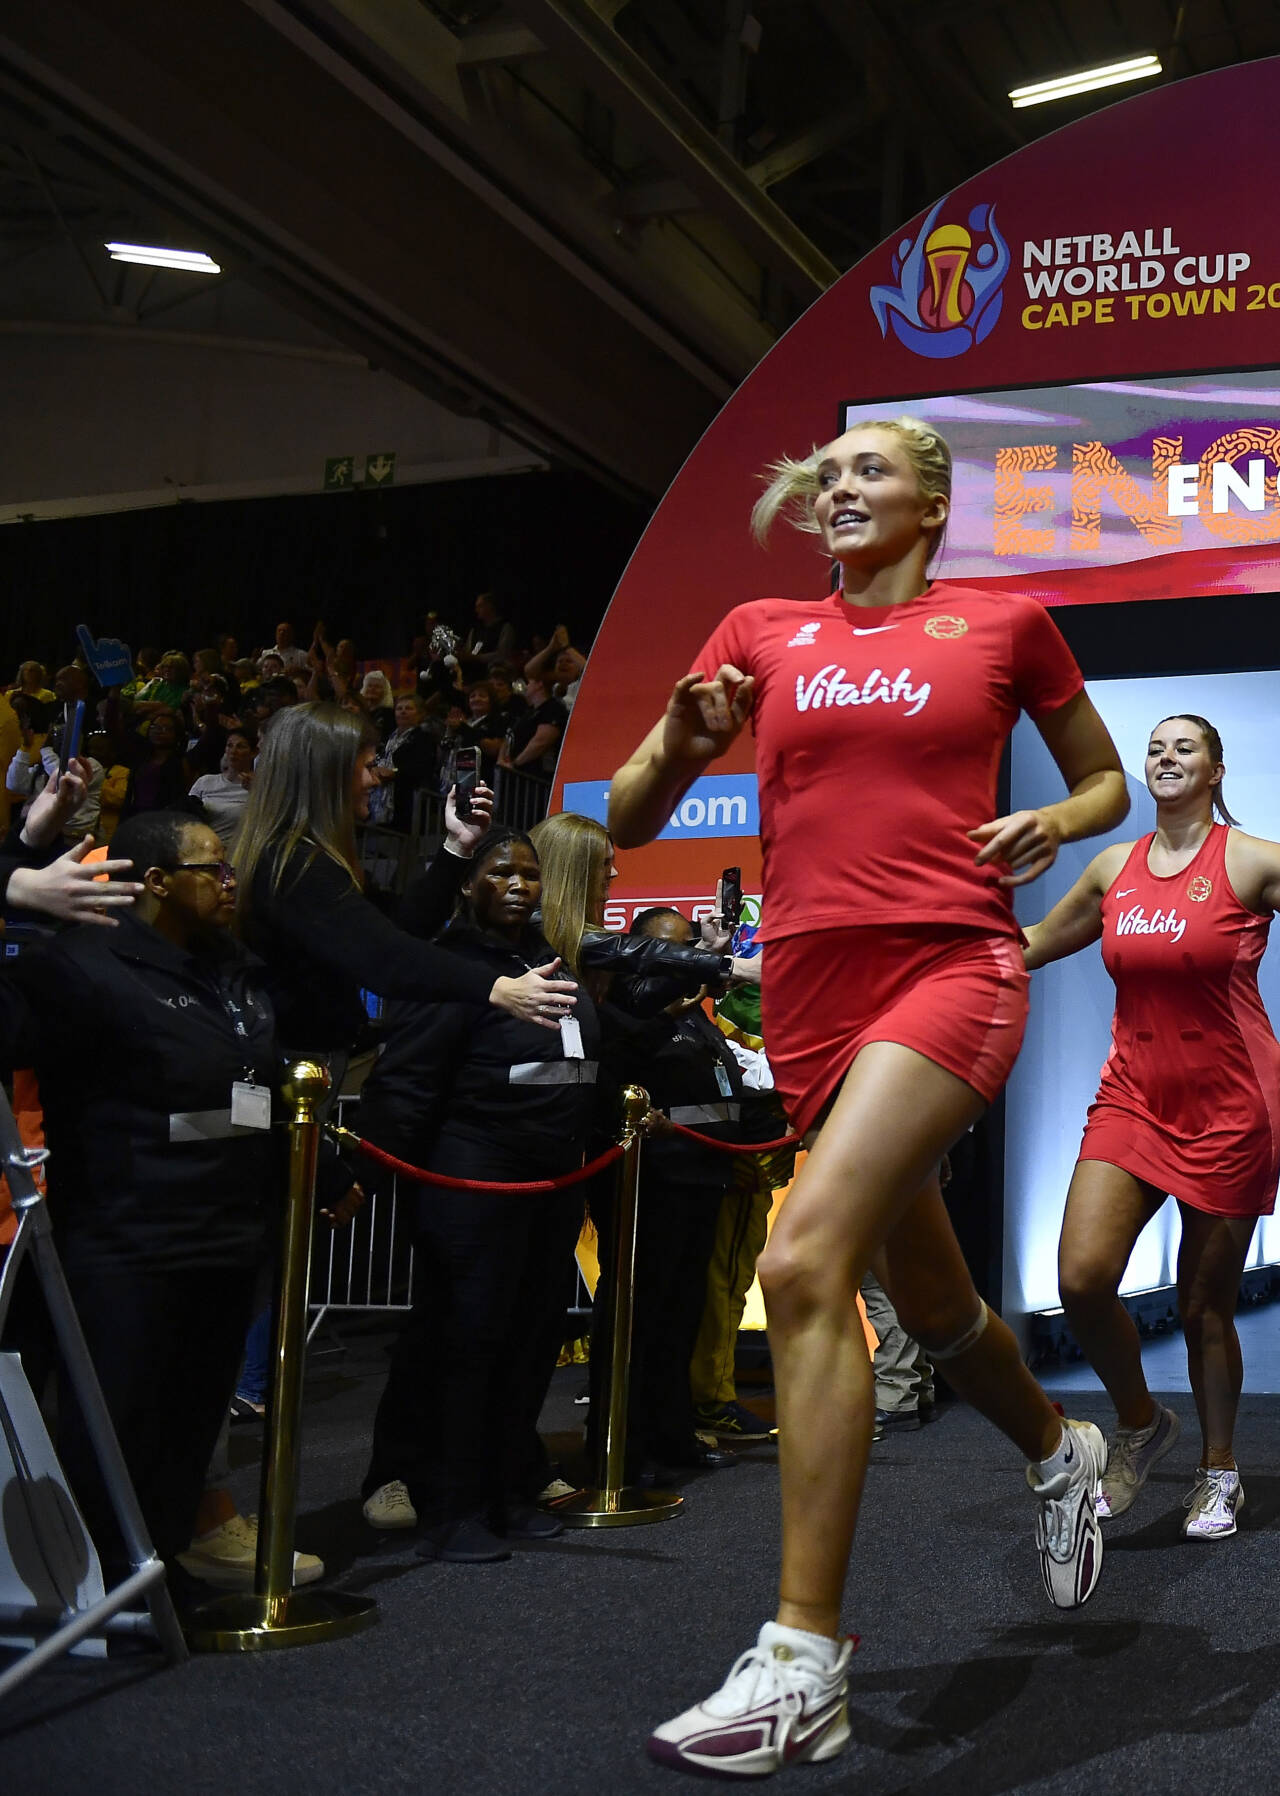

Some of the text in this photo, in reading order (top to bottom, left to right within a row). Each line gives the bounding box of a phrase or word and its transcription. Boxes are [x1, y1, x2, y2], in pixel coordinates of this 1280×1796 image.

[1022, 227, 1180, 268] NETBALL
[1023, 252, 1251, 300] WORLD CUP
[1021, 298, 1115, 330] CAPE
[1125, 286, 1237, 321] TOWN
[796, 664, 931, 717] Vitality
[1116, 904, 1187, 943] Vitality
